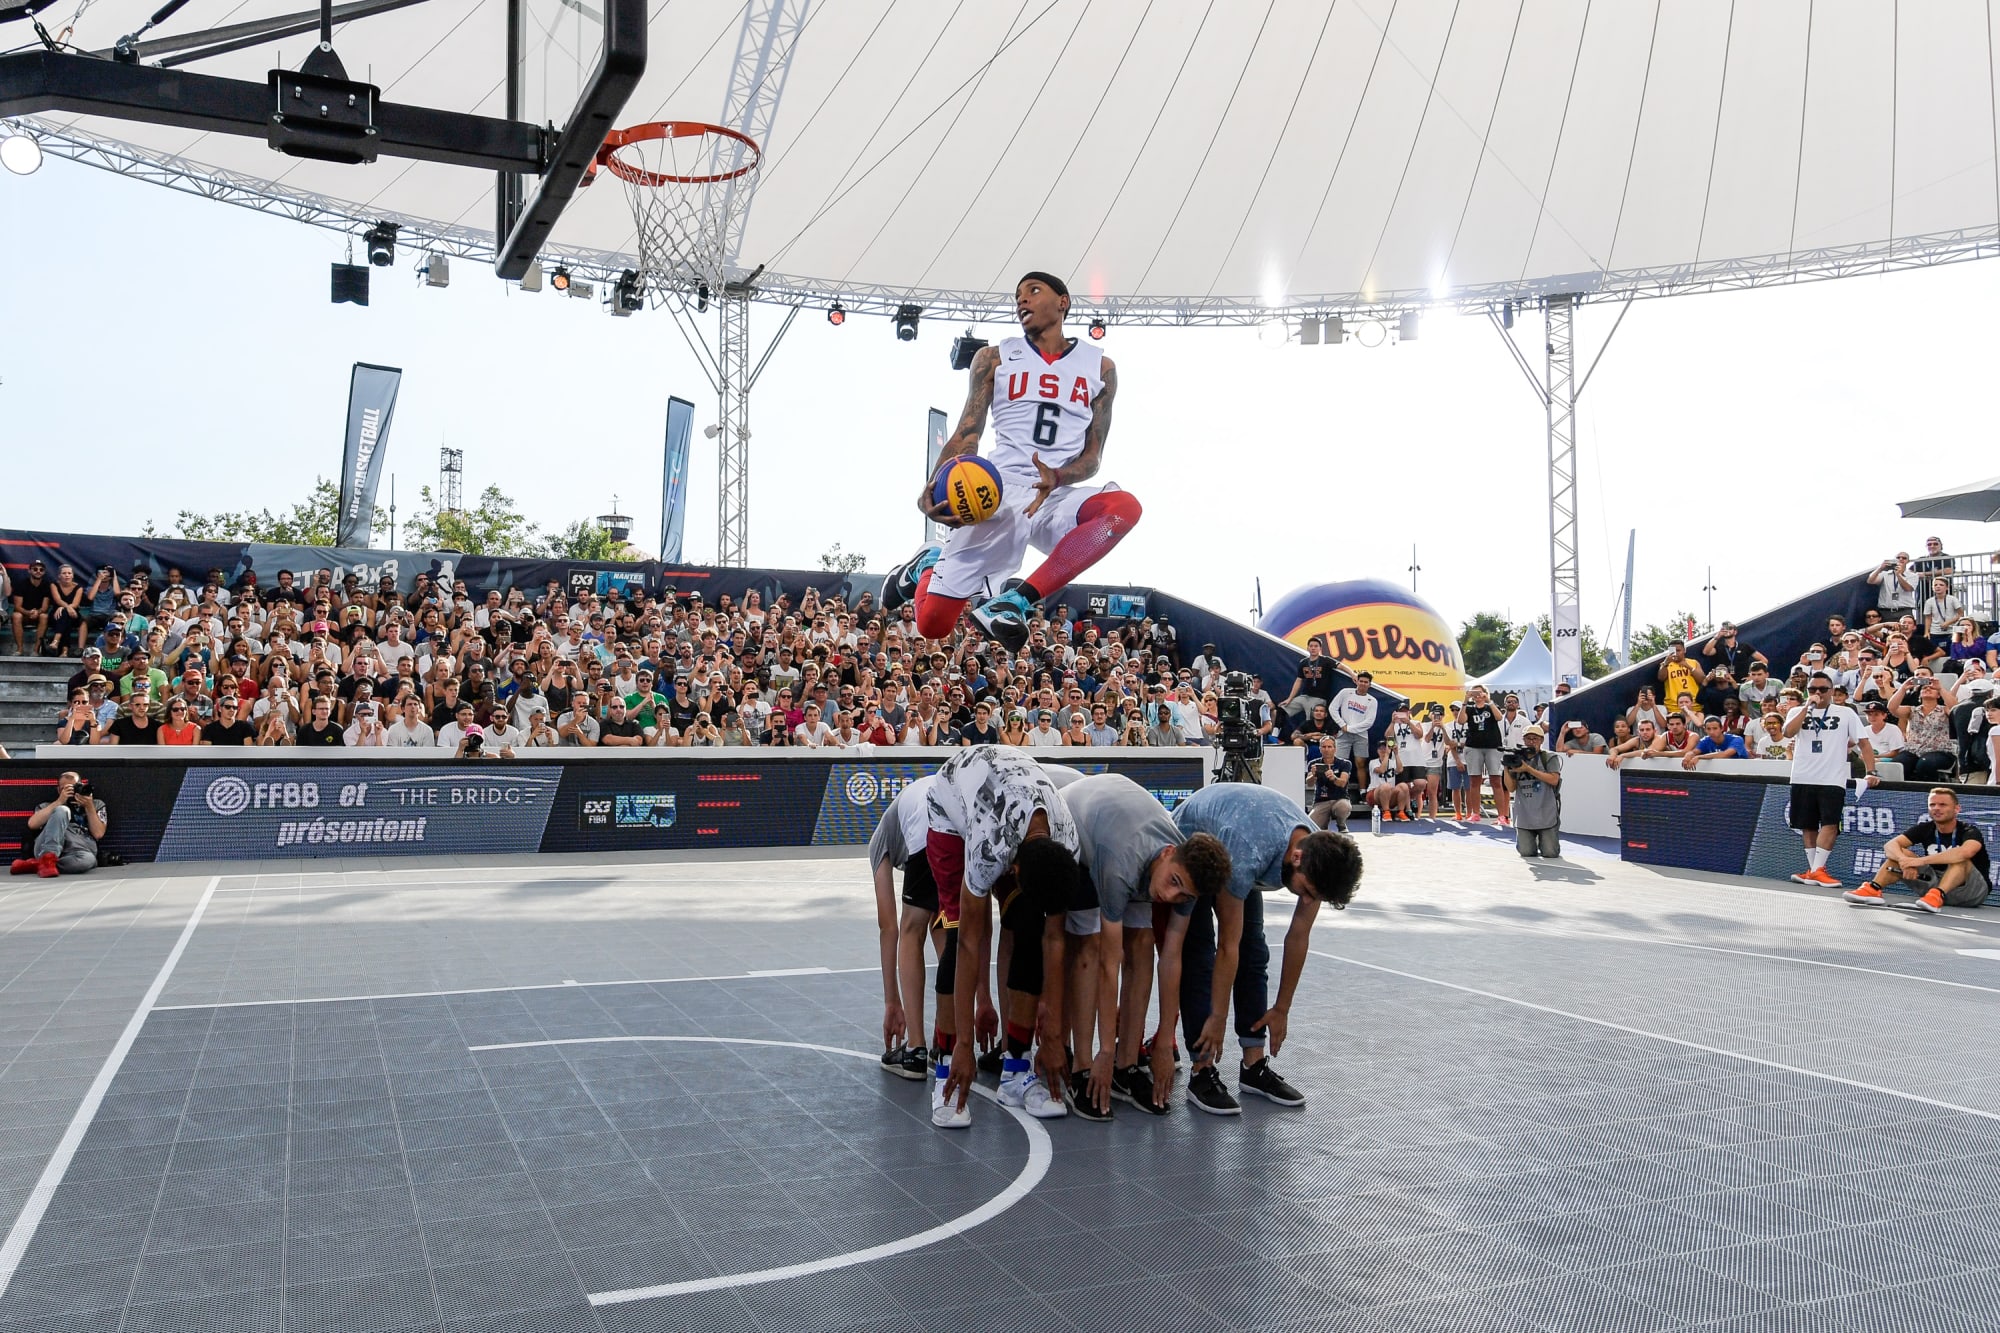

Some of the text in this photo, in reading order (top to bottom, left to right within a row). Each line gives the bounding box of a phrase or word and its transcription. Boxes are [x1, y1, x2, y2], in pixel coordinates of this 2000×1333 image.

[1008, 371, 1089, 408] USA
[1033, 402, 1060, 446] 6
[953, 479, 976, 523] Wilson
[1312, 624, 1458, 671] Wilson
[253, 782, 543, 809] FFBB et THE BRIDGE
[276, 816, 428, 847] présentent
[588, 815, 607, 824] FIBA
[1843, 805, 1896, 836] FBB
